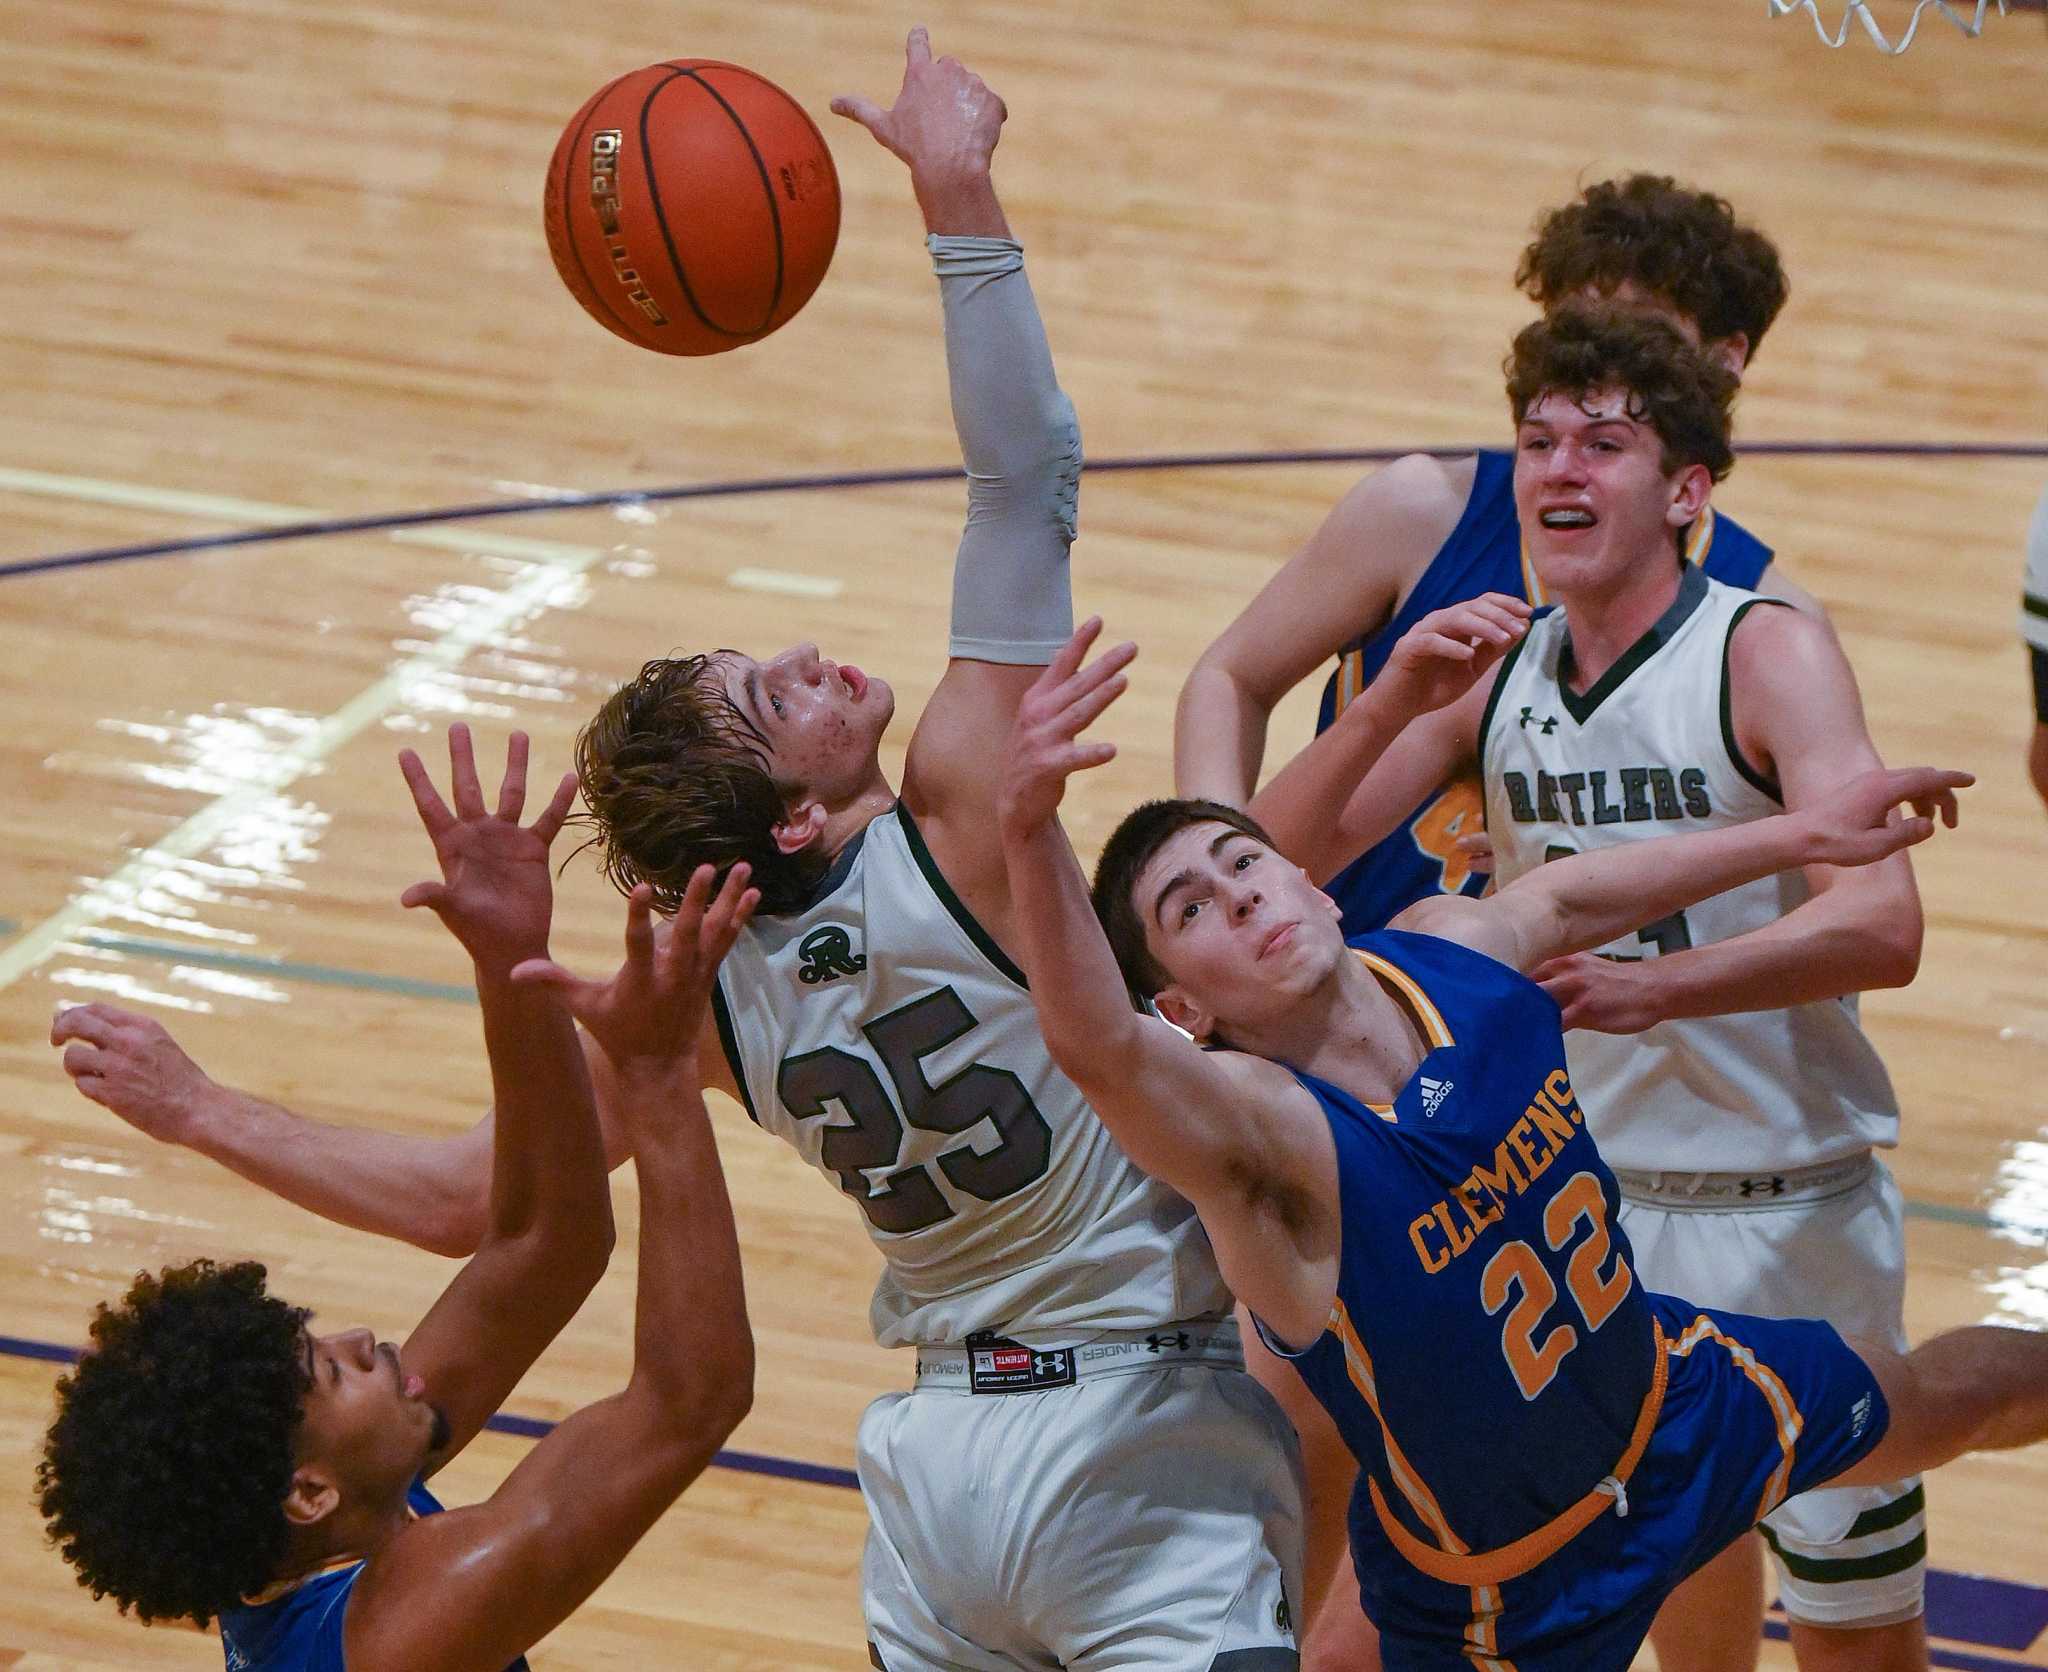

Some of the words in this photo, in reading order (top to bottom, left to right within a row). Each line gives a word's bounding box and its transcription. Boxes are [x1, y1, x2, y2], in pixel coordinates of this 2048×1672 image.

[592, 133, 619, 195] PRO
[1409, 781, 1497, 898] 4
[777, 984, 1052, 1234] 25
[1408, 1069, 1583, 1275] CLEMENS
[1425, 1080, 1454, 1118] adidas
[1480, 1171, 1632, 1401] 22
